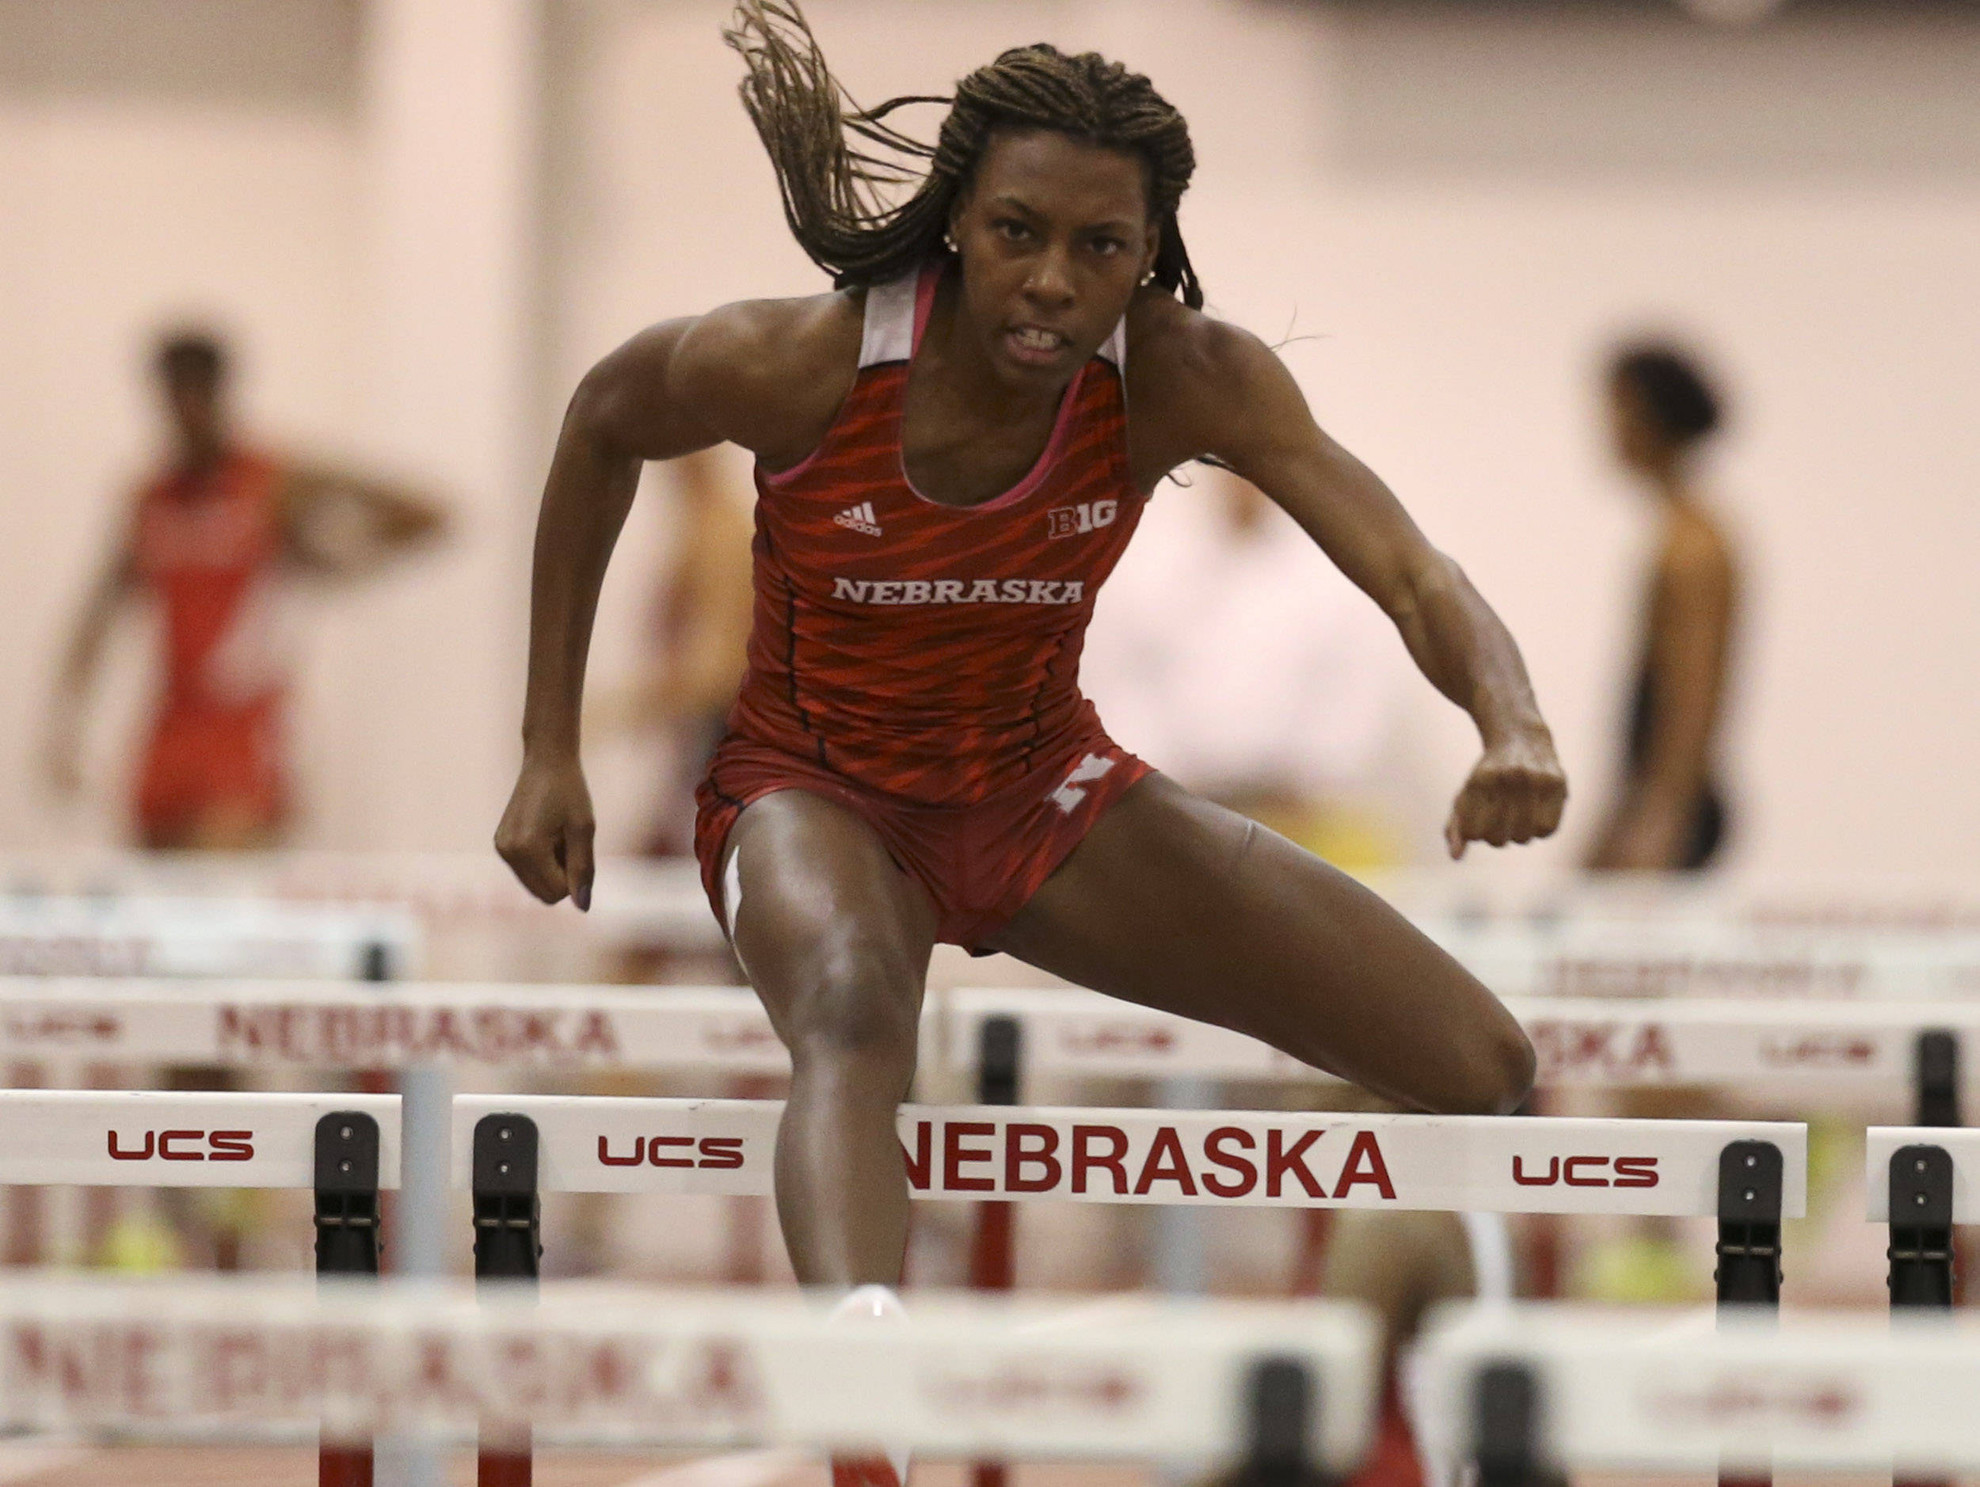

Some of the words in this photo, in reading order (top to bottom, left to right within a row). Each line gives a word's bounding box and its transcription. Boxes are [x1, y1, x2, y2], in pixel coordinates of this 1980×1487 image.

[833, 513, 882, 537] adidas
[832, 577, 1084, 605] NEBRASKA
[107, 1130, 255, 1161] UCS
[597, 1135, 744, 1169] UCS
[1512, 1155, 1659, 1188] UCS
